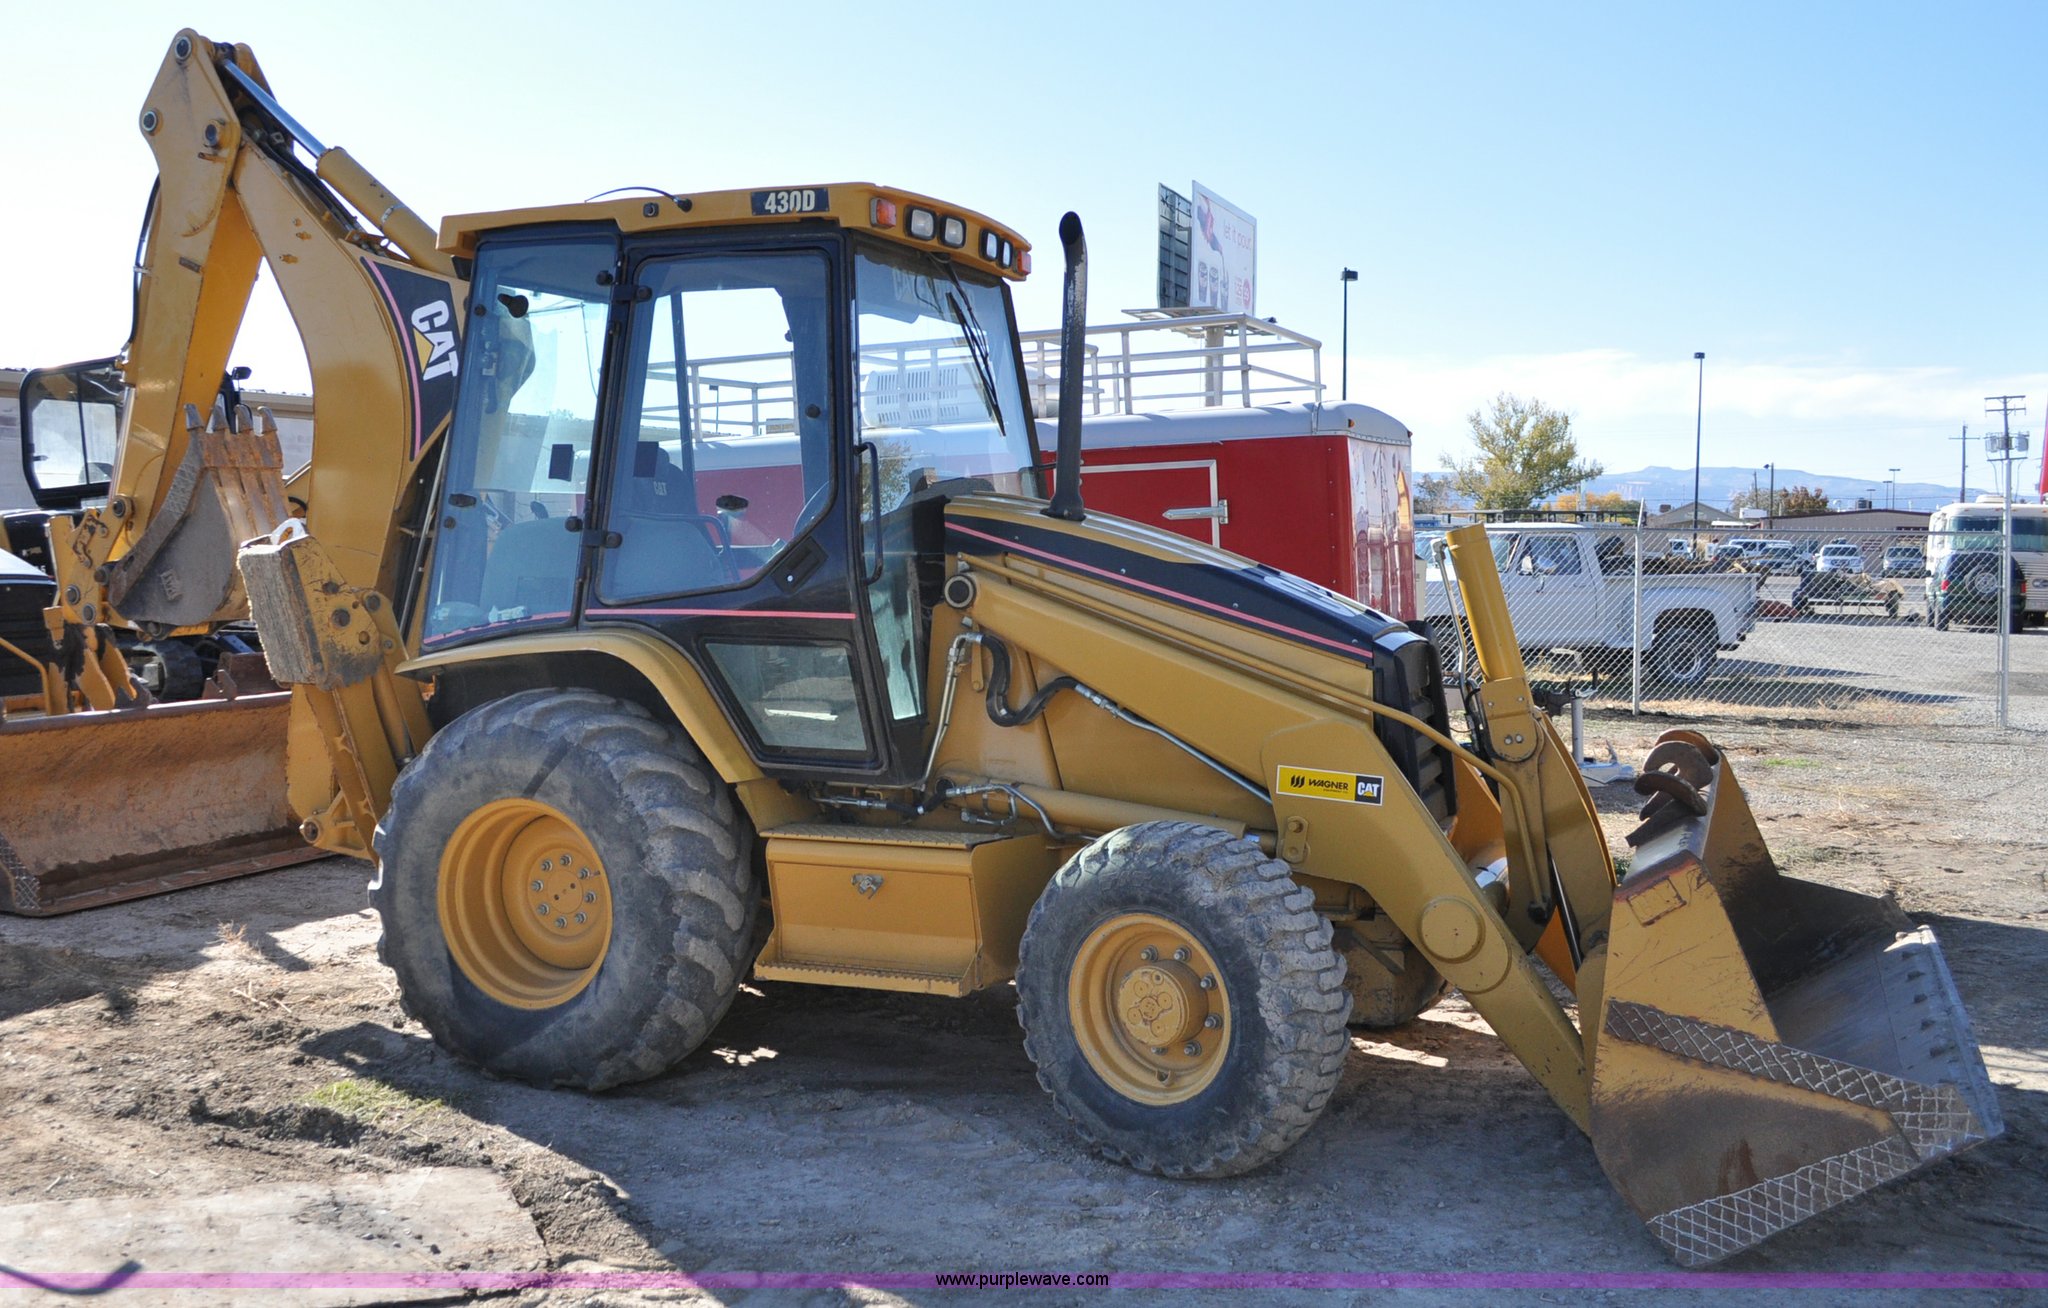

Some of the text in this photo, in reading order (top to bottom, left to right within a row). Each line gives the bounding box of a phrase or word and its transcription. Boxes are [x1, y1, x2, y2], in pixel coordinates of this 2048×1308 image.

[765, 190, 816, 213] 430D
[1238, 232, 1251, 251] pour
[411, 300, 459, 381] CAT
[1308, 778, 1349, 791] WAGNER
[1357, 781, 1380, 798] CAT
